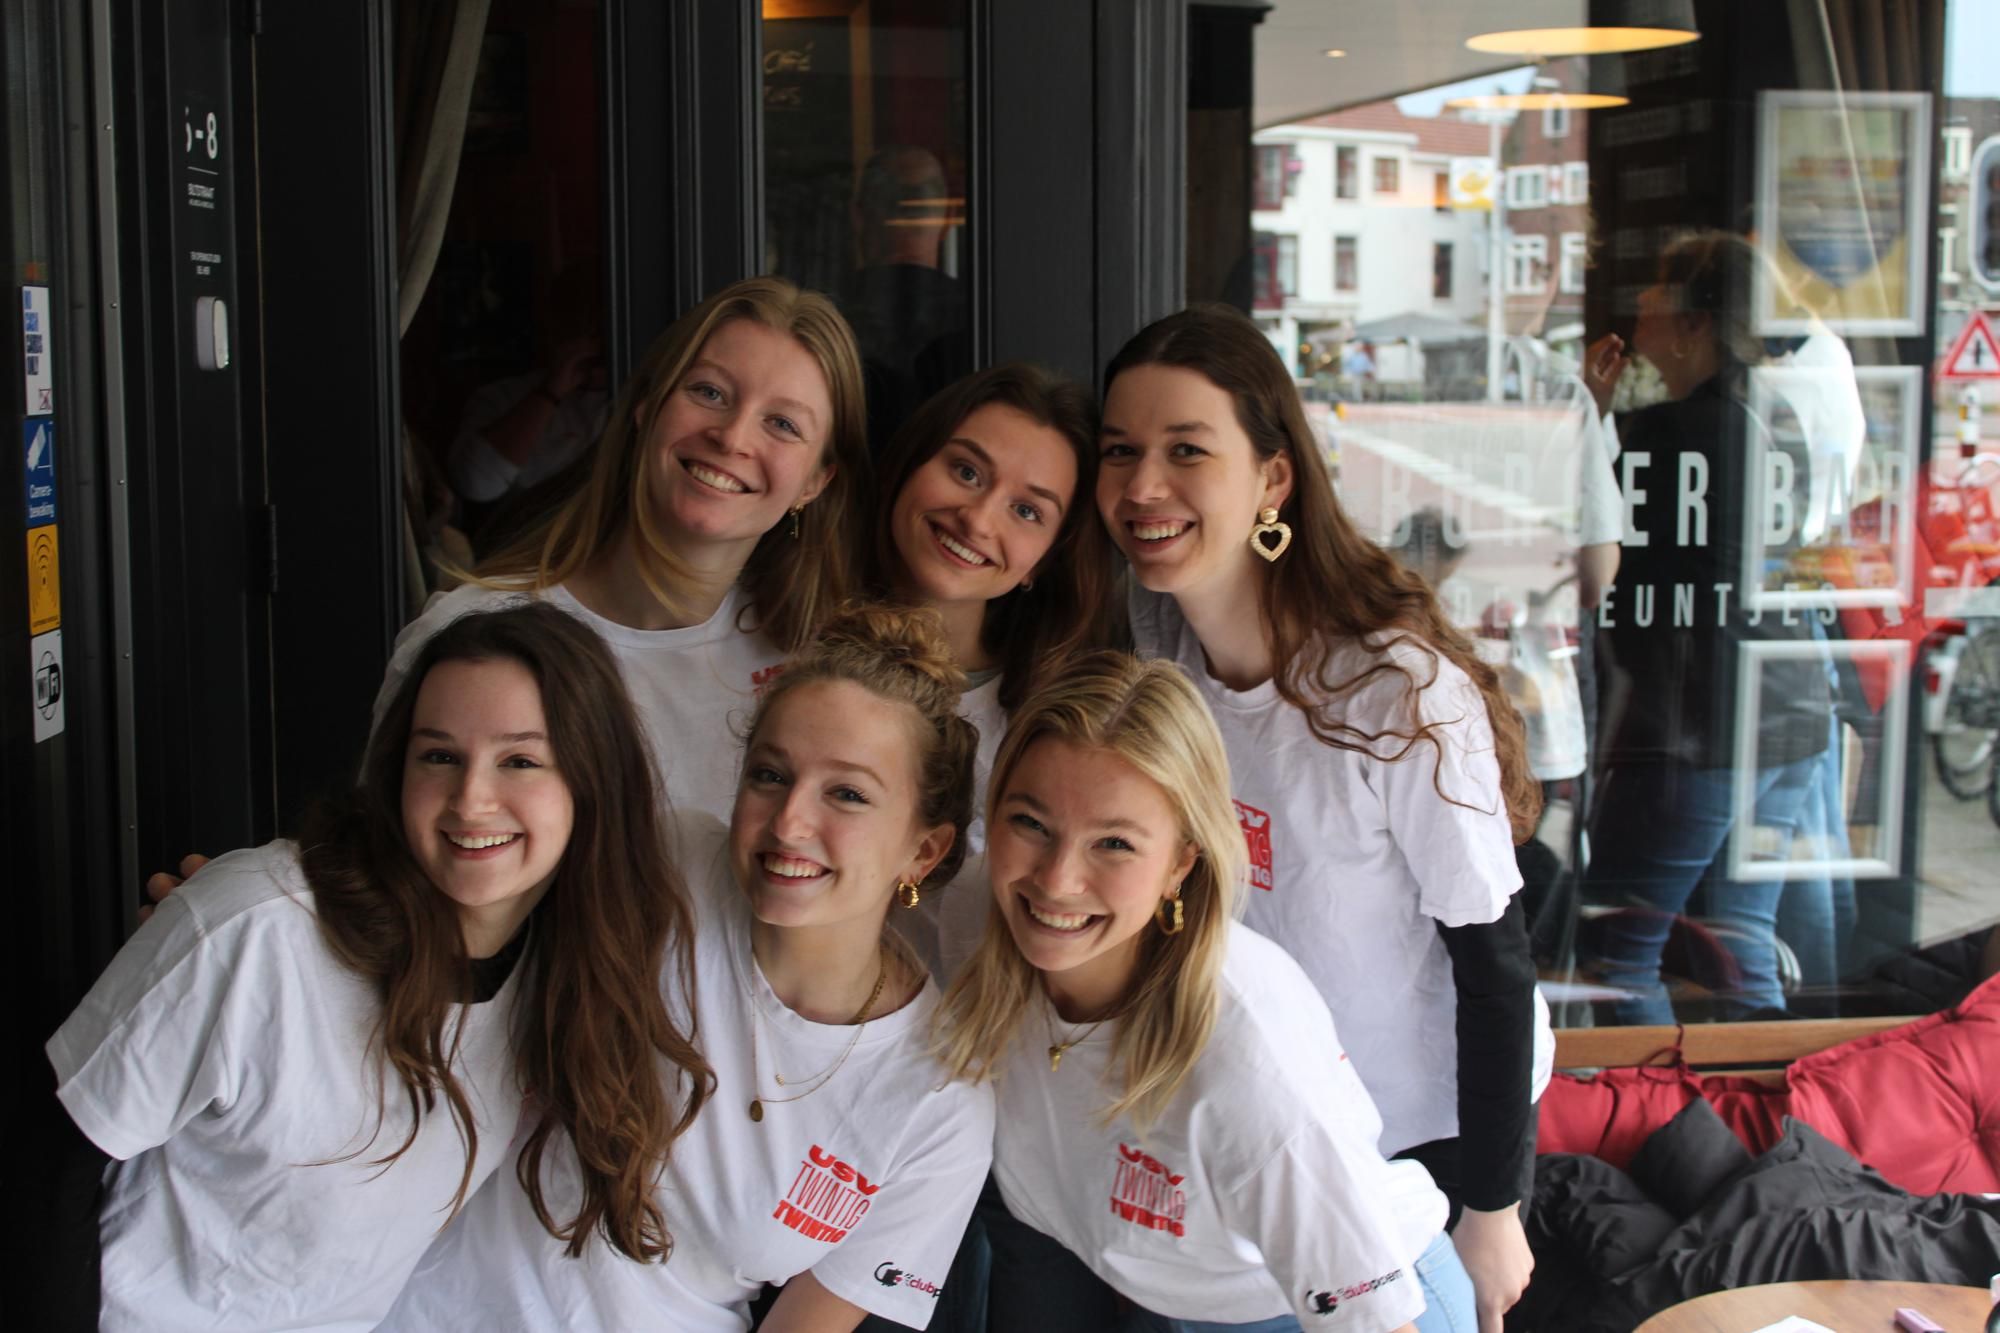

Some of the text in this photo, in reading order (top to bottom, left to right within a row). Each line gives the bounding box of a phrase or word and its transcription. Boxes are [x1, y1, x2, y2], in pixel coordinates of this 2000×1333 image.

[1764, 451, 1910, 547] BAR
[809, 1144, 880, 1196] USV
[1119, 1141, 1184, 1187] USV
[787, 1160, 870, 1229] TWINTIG
[773, 1199, 848, 1243] TWINTIG
